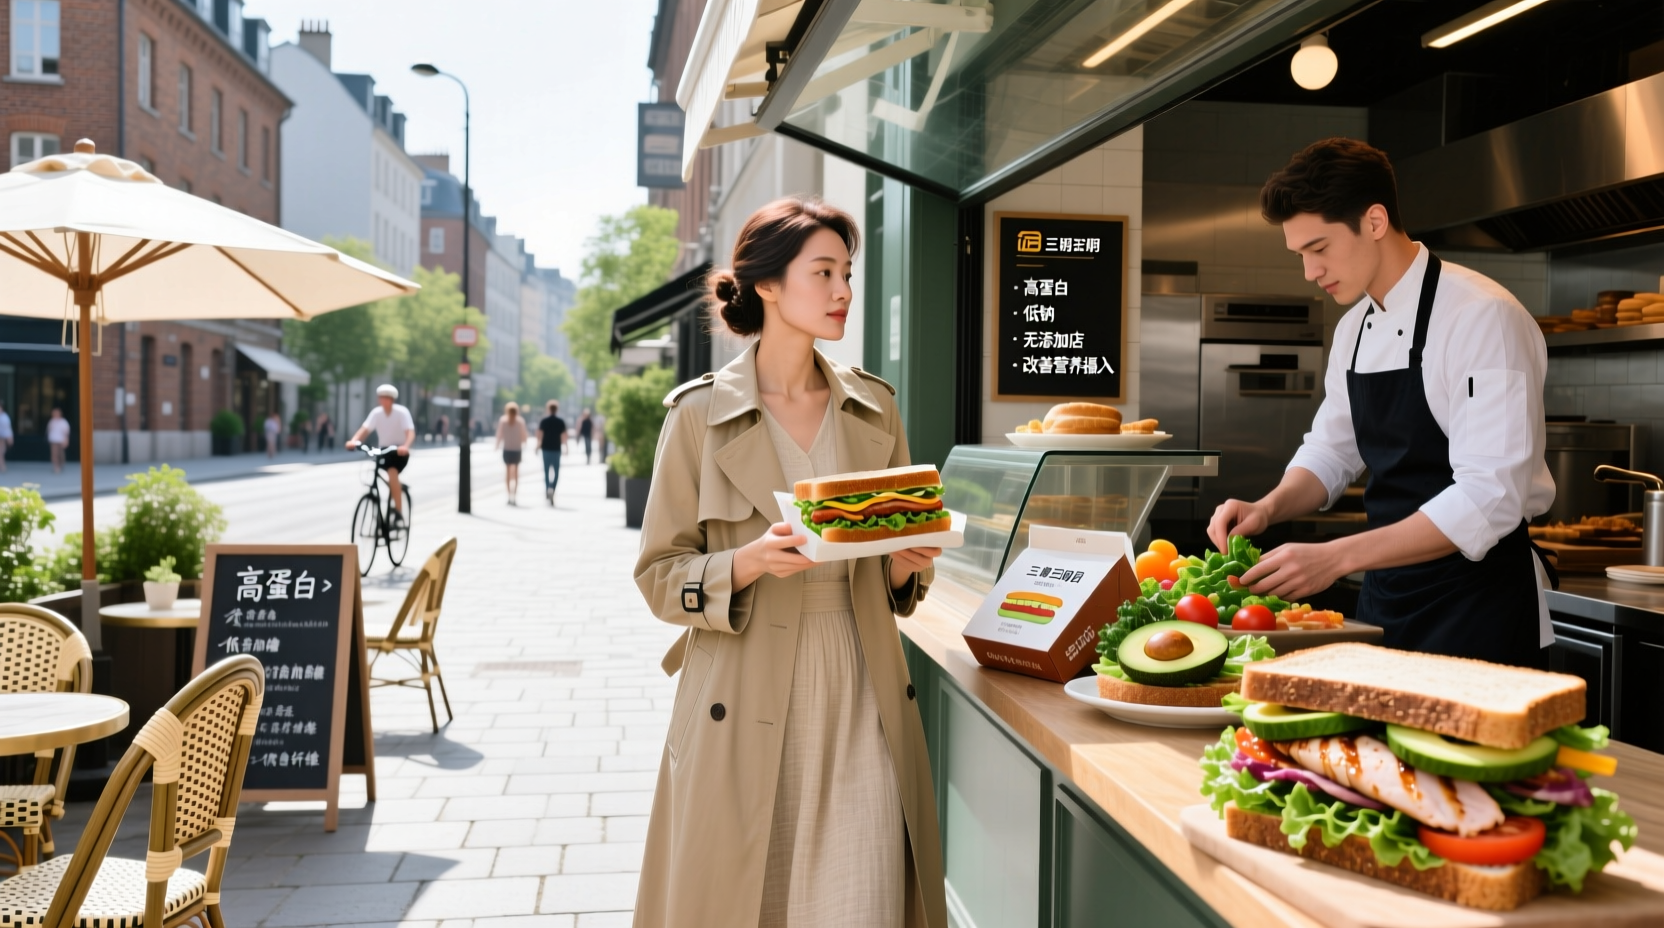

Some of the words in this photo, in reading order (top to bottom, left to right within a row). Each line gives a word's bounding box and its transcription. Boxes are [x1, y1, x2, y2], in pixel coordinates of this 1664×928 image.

[1023, 276, 1068, 297] 高蛋白
[236, 565, 316, 602] 高蛋白
